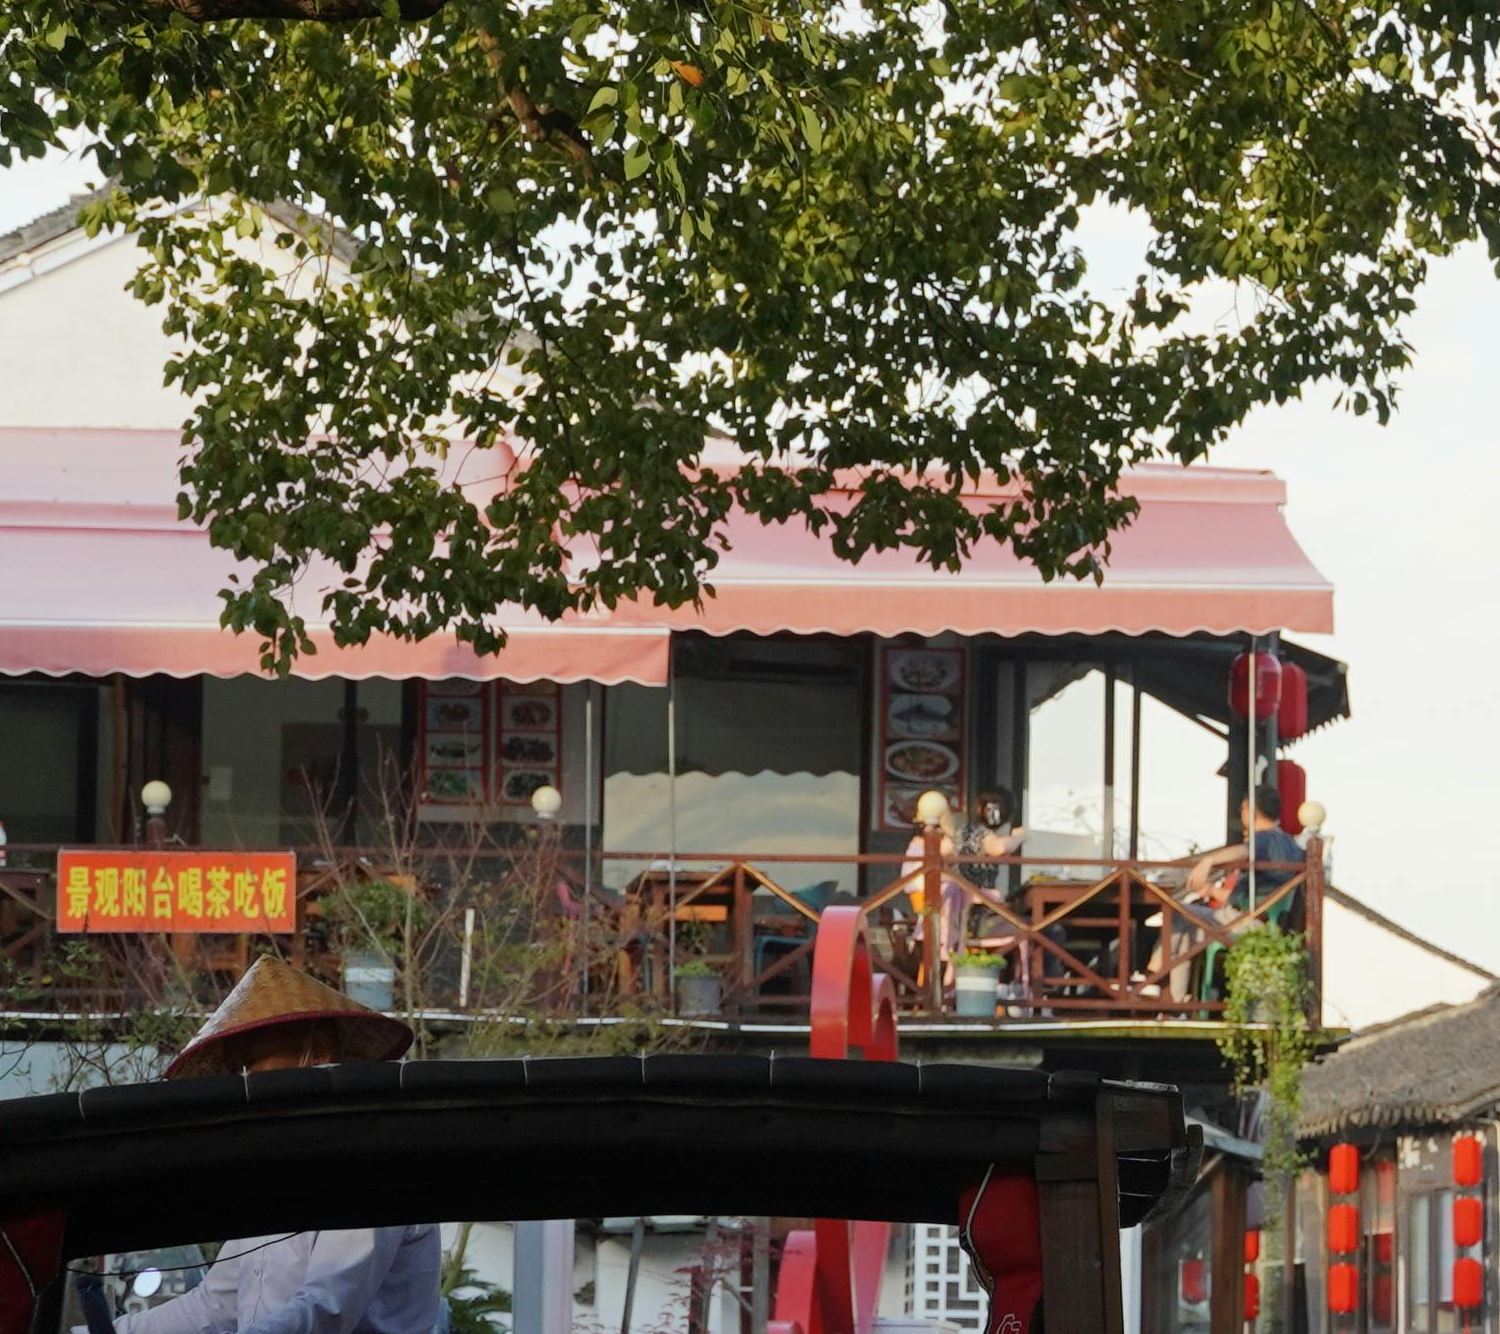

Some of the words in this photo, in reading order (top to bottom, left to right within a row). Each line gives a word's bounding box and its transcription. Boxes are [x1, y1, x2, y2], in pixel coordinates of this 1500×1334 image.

[66, 867, 287, 919] 景观阳台喝茶吃饭
